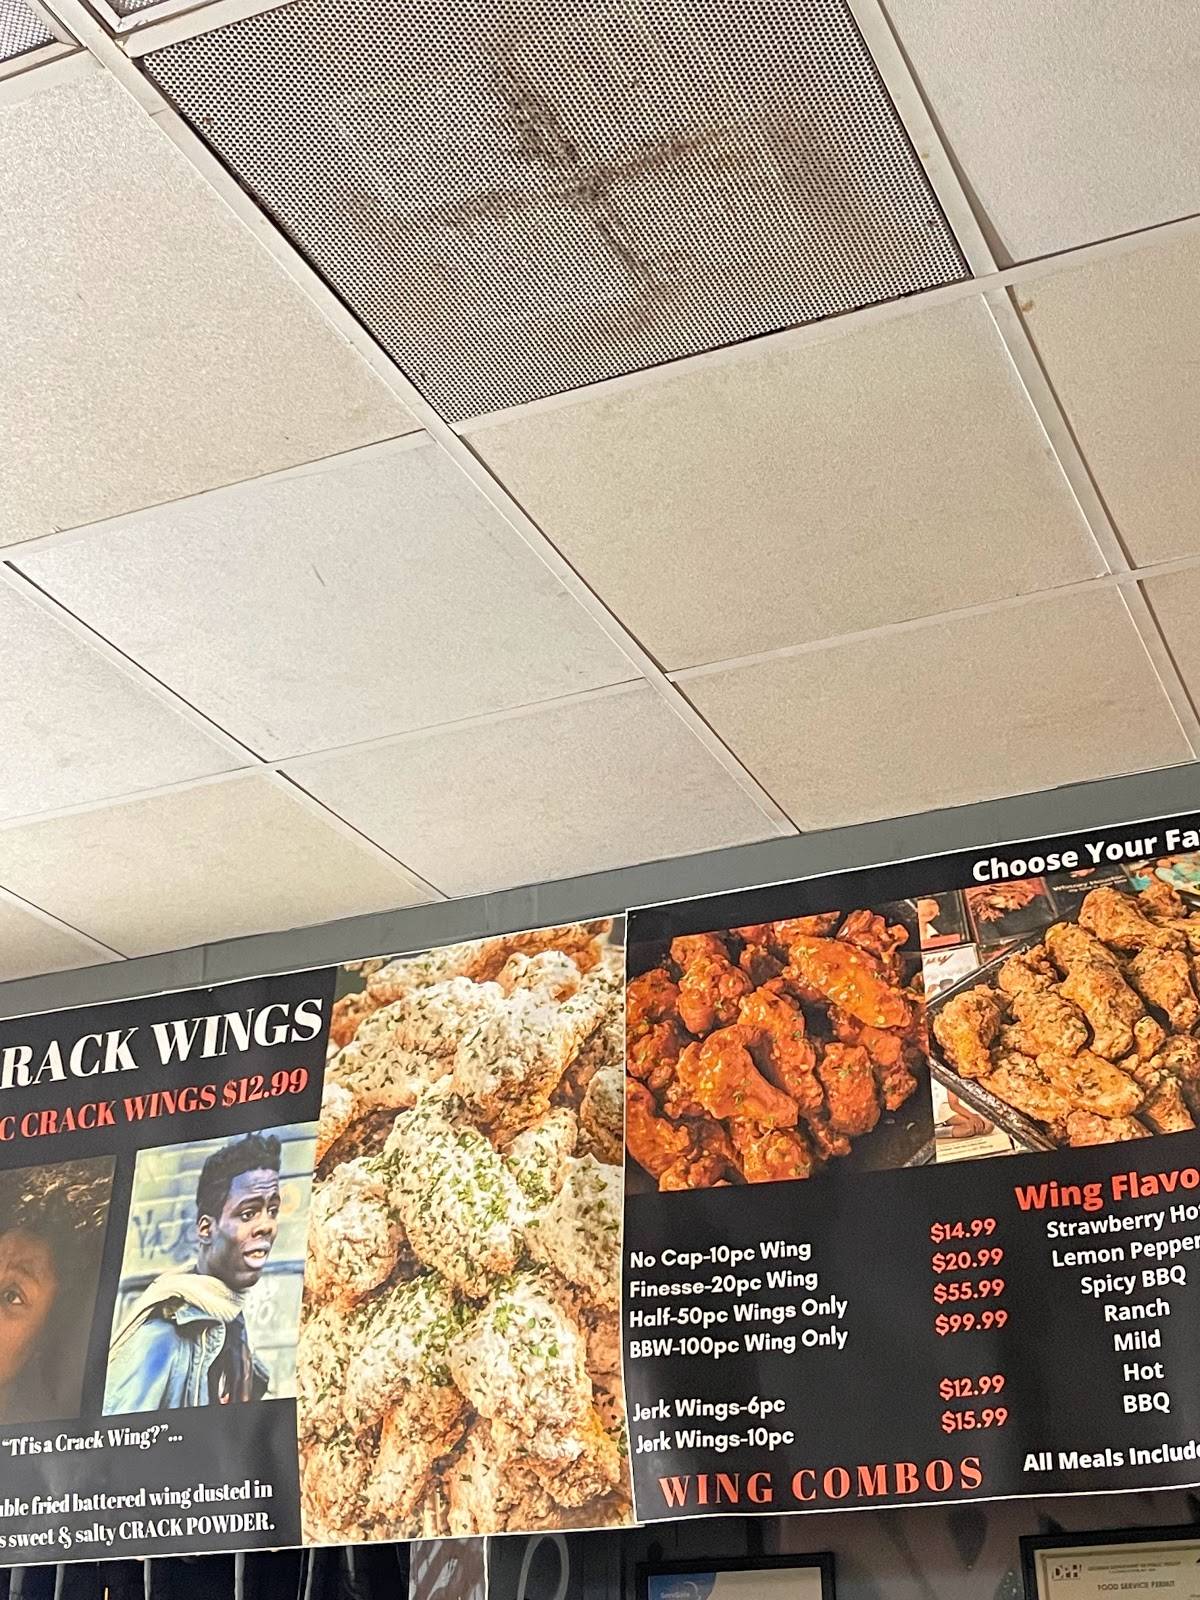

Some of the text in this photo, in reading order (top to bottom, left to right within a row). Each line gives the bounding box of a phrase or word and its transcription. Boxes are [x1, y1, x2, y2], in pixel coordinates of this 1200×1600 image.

[972, 829, 1200, 882] Choose Your Fa
[151, 998, 323, 1065] WINGS
[20, 1099, 116, 1138] CRACK
[123, 1084, 217, 1122] WINGS
[222, 1067, 309, 1107] $12.99
[1014, 1180, 1104, 1211] Wing
[929, 1217, 996, 1243] $14.99
[1046, 1210, 1165, 1239] Strawberry
[630, 1241, 811, 1270] No Cap-10pc Wing
[931, 1248, 1004, 1274] $20.99
[1052, 1247, 1125, 1268] Lemon
[630, 1270, 818, 1298] Finesse-20pc Wing
[933, 1278, 1005, 1304] $55.99
[1080, 1265, 1187, 1298] Spicy BBQ
[629, 1295, 848, 1329] Half-50pc Wings Only
[935, 1310, 1008, 1336] $99.99
[1104, 1298, 1171, 1322] Ranch
[630, 1325, 848, 1359] BBW-100pc Wing Only
[1114, 1329, 1161, 1352] Mild
[1123, 1362, 1165, 1381] Hot
[939, 1375, 1005, 1400] $12.99
[632, 1396, 786, 1421] Jerk Wings-6pc
[1123, 1392, 1171, 1414] BBQ
[941, 1407, 1008, 1433] $15.99
[55, 1430, 104, 1452] Crack
[635, 1427, 795, 1454] Jerk Wings-10pc
[1023, 1451, 1053, 1472] All
[1058, 1448, 1125, 1470] Meals
[658, 1456, 985, 1508] WING COMBOS
[31, 1494, 70, 1515] fried
[72, 1488, 146, 1512] battered
[149, 1486, 192, 1509] wing
[193, 1482, 251, 1502] dusted
[254, 1480, 273, 1499] in
[8, 1528, 55, 1548] sweet
[58, 1526, 73, 1549] &
[75, 1522, 116, 1546] salty
[119, 1518, 183, 1540] CRACK
[187, 1511, 276, 1535] POWDER.
